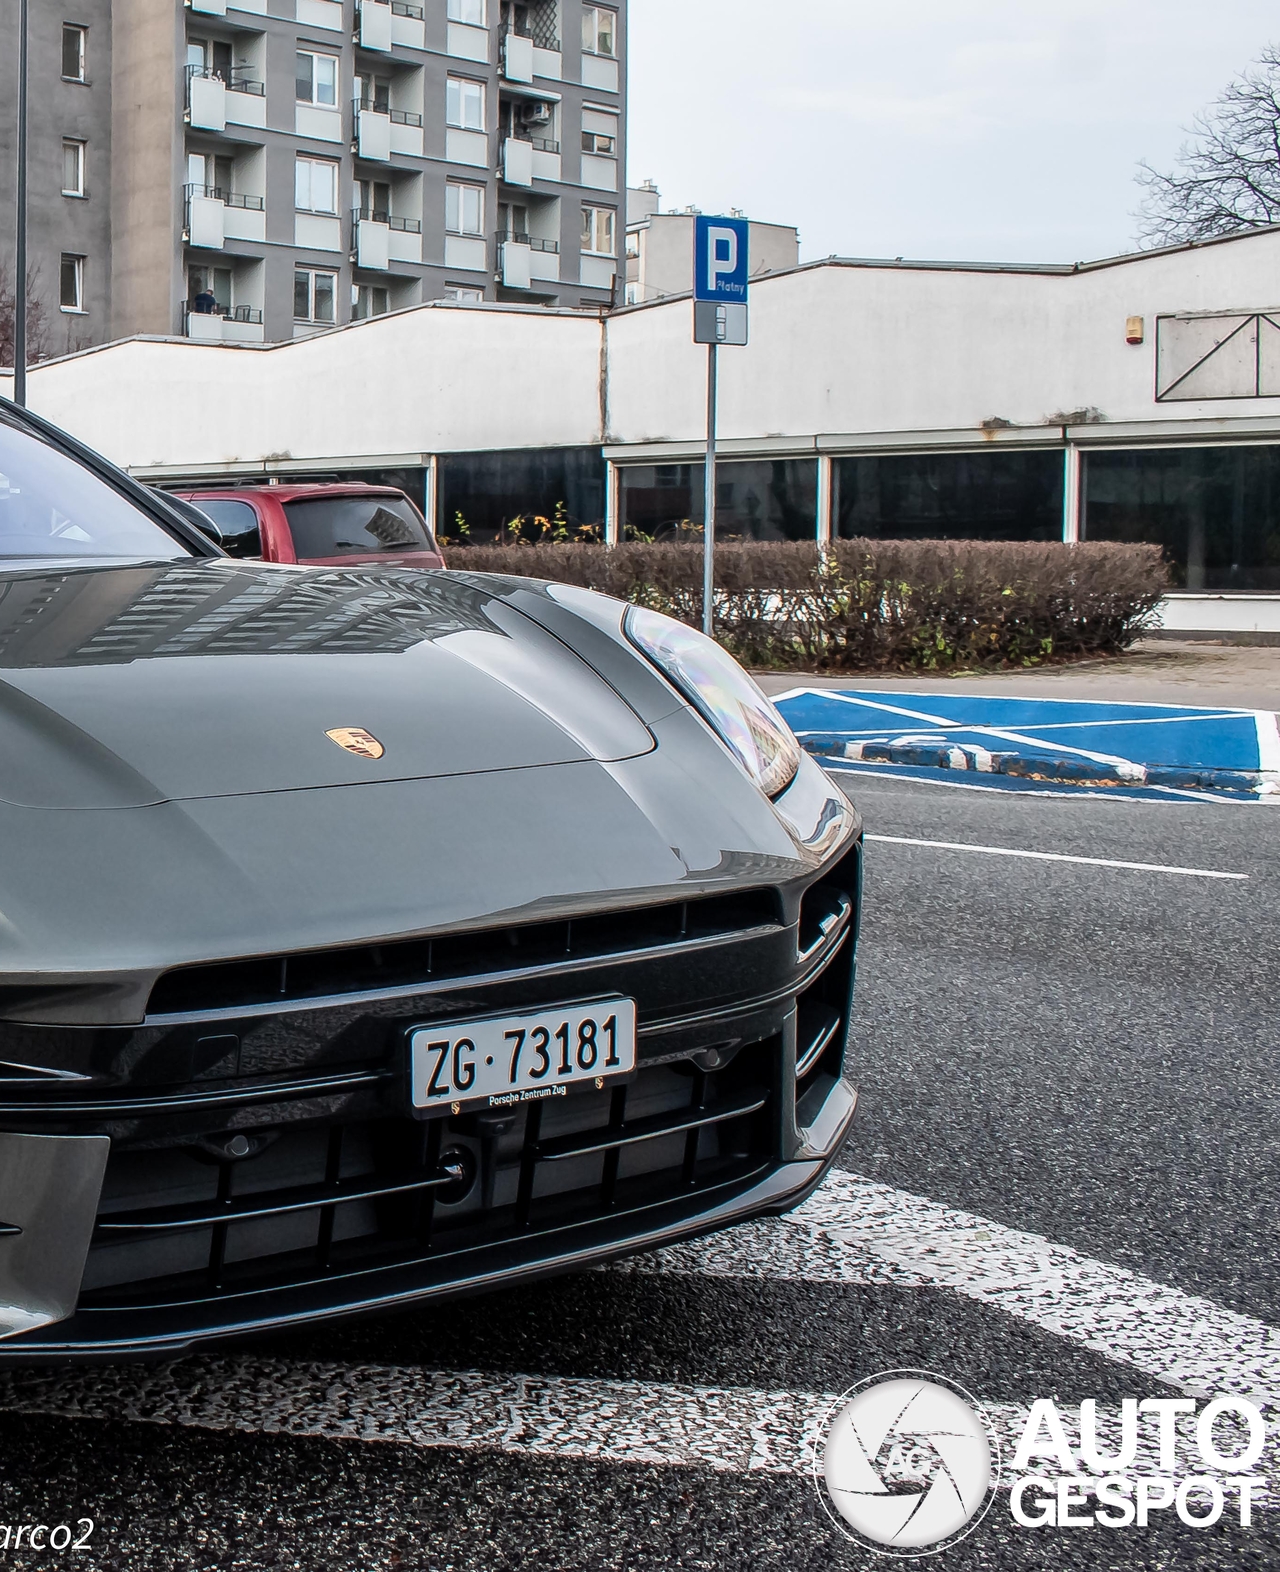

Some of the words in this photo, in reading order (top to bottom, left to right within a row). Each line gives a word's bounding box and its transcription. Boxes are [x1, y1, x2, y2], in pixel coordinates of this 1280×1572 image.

[707, 226, 737, 290] P
[489, 1093, 519, 1106] Porsche
[520, 1088, 551, 1100] Zentrum
[552, 1085, 566, 1095] Zug
